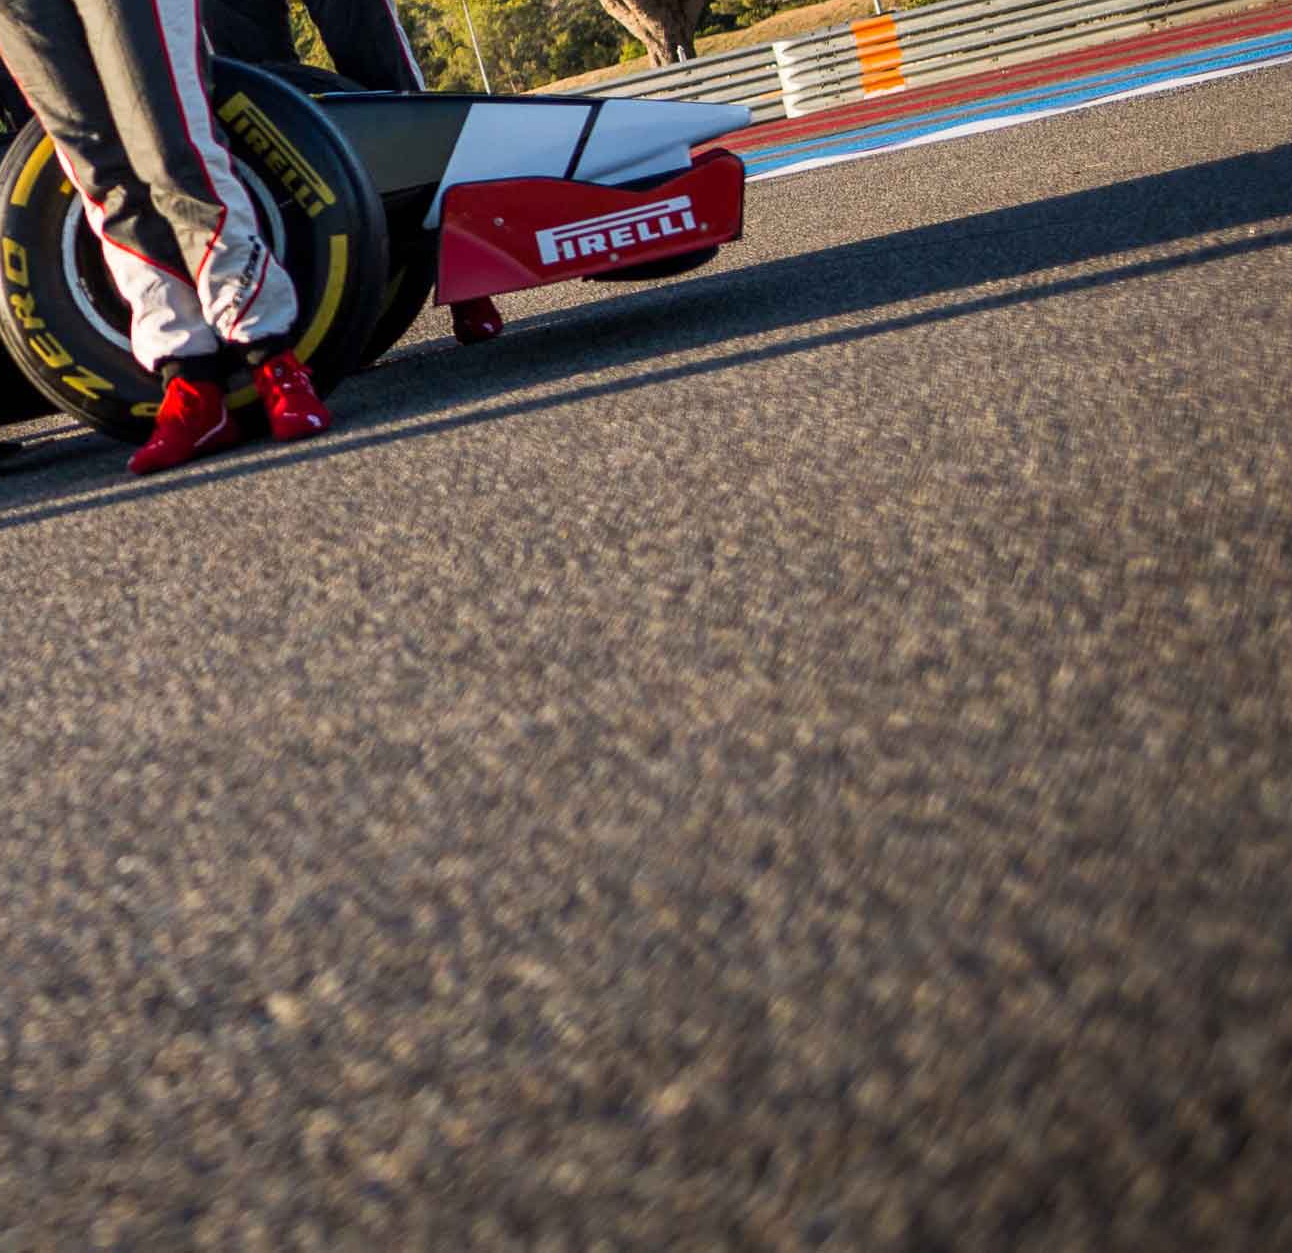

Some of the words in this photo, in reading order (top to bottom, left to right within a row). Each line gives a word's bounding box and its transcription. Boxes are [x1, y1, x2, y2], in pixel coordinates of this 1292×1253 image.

[218, 91, 336, 219] PIRELLI
[535, 195, 697, 266] PIRELLI
[2, 235, 115, 401] ZERO
